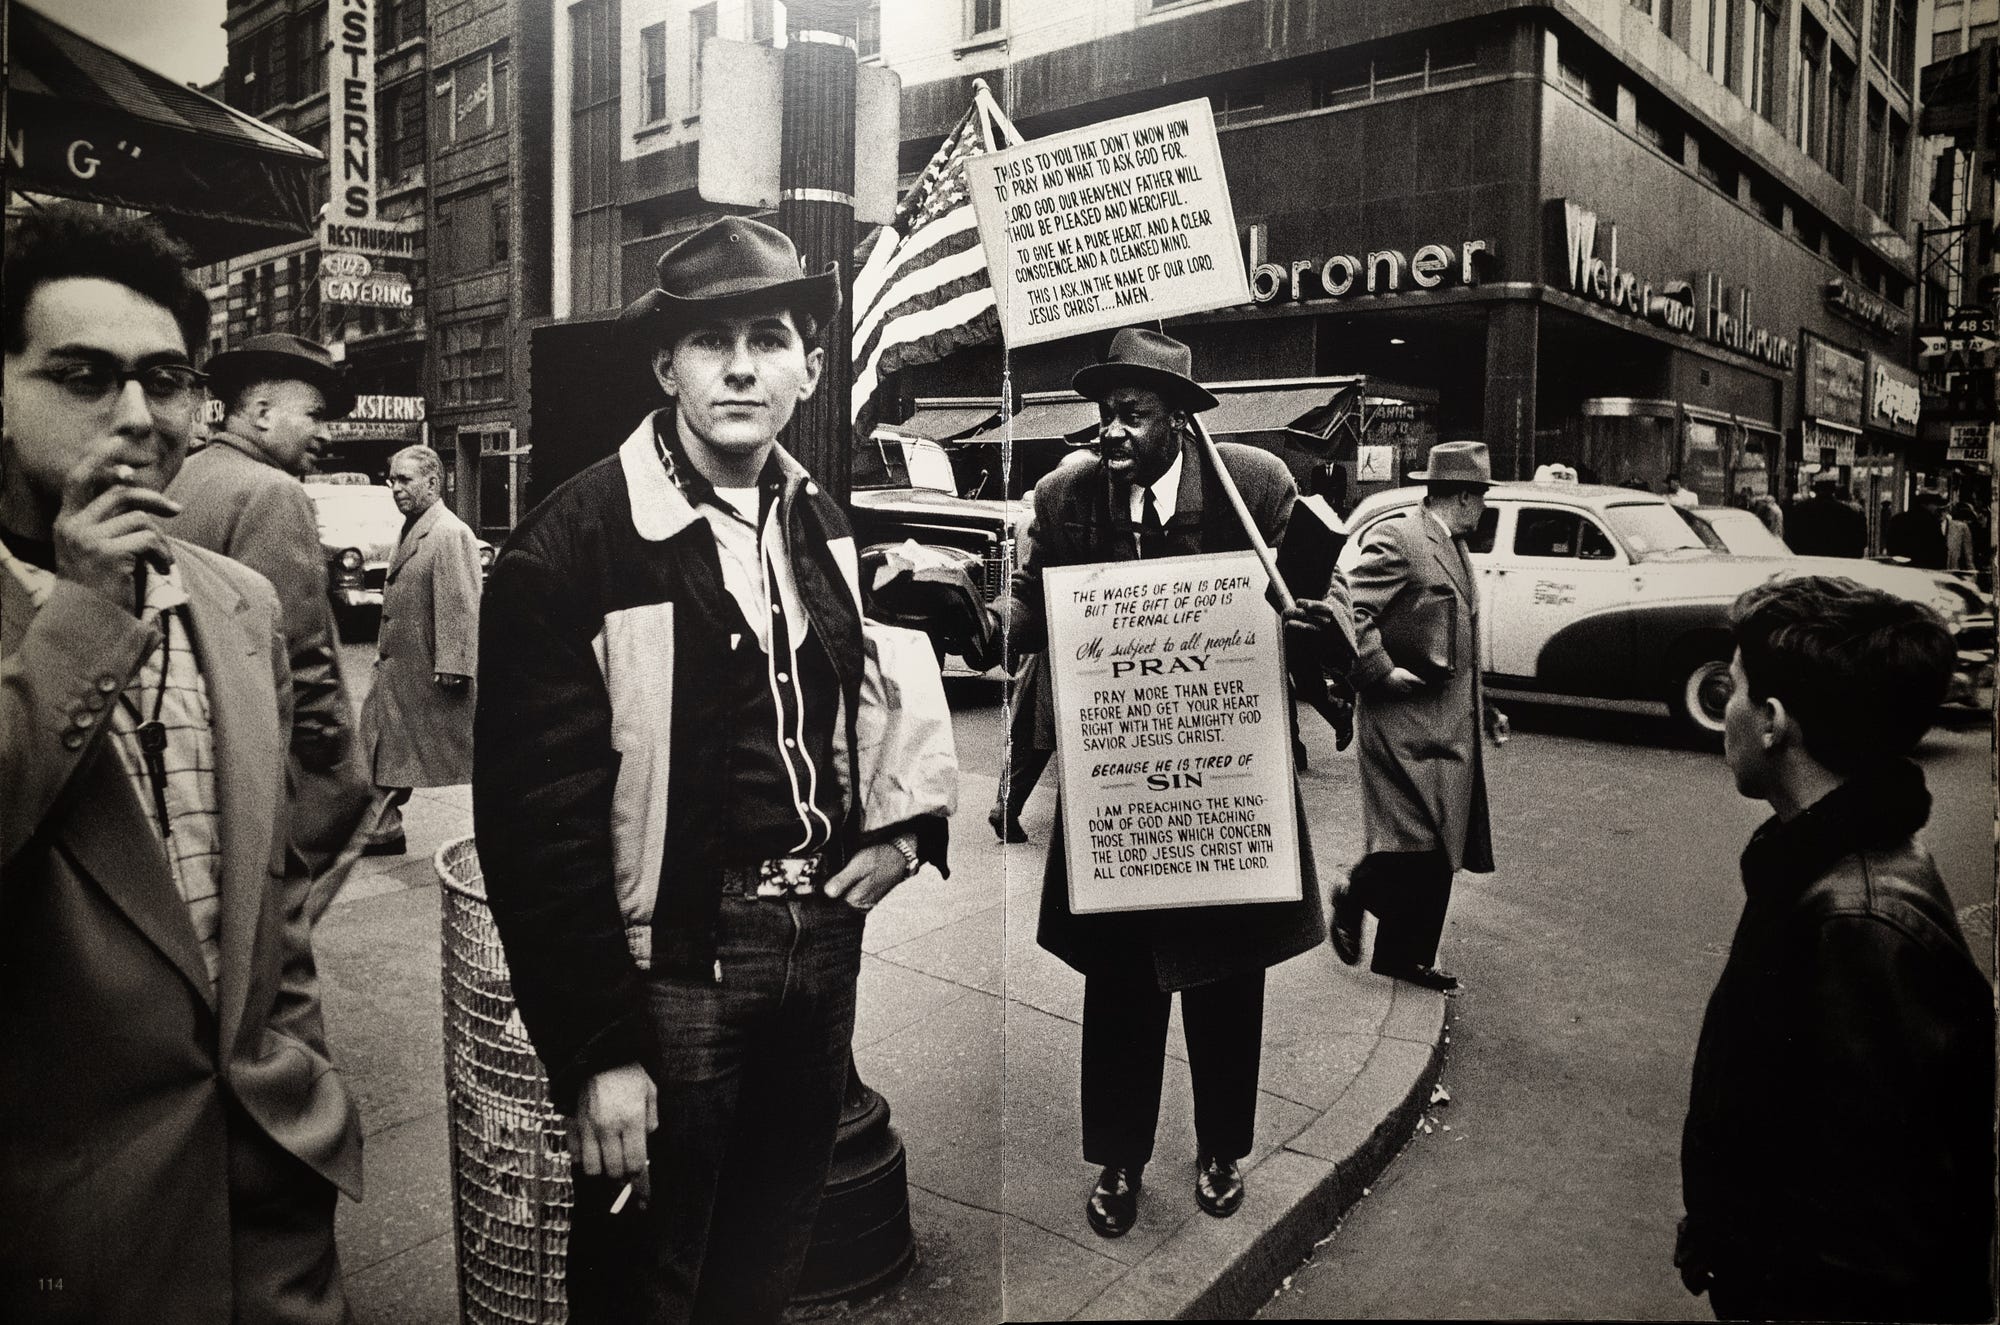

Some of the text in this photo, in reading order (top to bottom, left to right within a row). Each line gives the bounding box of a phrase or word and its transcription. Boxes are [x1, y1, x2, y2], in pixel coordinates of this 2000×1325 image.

[343, 0, 369, 218] STERNS
[993, 119, 1189, 184] THIS IS TO YOU THAT DON'T KNOW HOW
[994, 141, 1187, 203] TO PRAY AND WHAT TO ASK GOD FOR.
[1058, 191, 1079, 211] OUR
[1079, 178, 1132, 206] HEAVENLY
[1136, 169, 1175, 193] FATHER
[1174, 165, 1203, 184] WILL
[1038, 217, 1053, 236] BE
[1054, 206, 1102, 232] PLEASED
[1104, 201, 1128, 221] AND
[1128, 189, 1188, 215] MERCIFUL.
[328, 223, 413, 253] RESTAURANT
[1017, 248, 1030, 265] TO
[1033, 242, 1056, 262] GIVE
[1057, 238, 1074, 257] ME
[1075, 237, 1084, 252] A
[1084, 230, 1112, 250] PURE
[1147, 217, 1169, 237] AND
[1171, 216, 1180, 232] A
[1180, 209, 1212, 230] CLEAR
[1076, 252, 1098, 271] AND
[1100, 250, 1109, 266] A
[1110, 239, 1160, 264] CLEANSED
[1160, 233, 1191, 254] MIND.
[1027, 287, 1051, 305] THIS
[1053, 286, 1059, 301] I
[1080, 278, 1094, 295] IN
[1093, 274, 1114, 292] THE
[1114, 267, 1145, 288] NAME
[1147, 264, 1161, 281] OF
[1163, 259, 1186, 279] OUR
[1187, 254, 1215, 274] LORD.
[1565, 201, 1652, 317] Weber
[1706, 271, 1798, 370] Heilbroner
[327, 280, 413, 306] CATERING
[1028, 304, 1061, 326] JESUS
[1958, 320, 1977, 332] 48
[350, 395, 425, 421] KSTERN'S
[1073, 590, 1096, 604] THE
[1103, 584, 1147, 601] WAGES
[1153, 583, 1167, 596] OF
[1173, 581, 1192, 595] SIN
[1198, 580, 1208, 592] IS
[1085, 592, 1233, 618] BUT THE GIFT OF GOD IS
[1112, 613, 1169, 629] ETERNAL
[1076, 636, 1104, 663] My
[1109, 637, 1156, 660] subject
[1163, 636, 1174, 652] to
[1205, 629, 1242, 655] people
[1244, 631, 1256, 646] is
[1112, 653, 1211, 678] PRAY
[1094, 680, 1245, 704] PRAY MORE THAN EVER
[1079, 694, 1260, 722] BEFORE AND GET YOUR HEART
[1081, 709, 1262, 737] RIGHT WITH THE ALMIGHTY GOD
[1083, 728, 1225, 751] SAVIOR JESUS CHRIST.
[1091, 761, 1150, 778] BECAUSE
[1155, 759, 1173, 773] HE
[1177, 758, 1190, 771] IS
[1195, 755, 1233, 769] TIRED
[1146, 772, 1203, 791] SIN
[1096, 807, 1101, 817] I
[1104, 804, 1122, 817] AM
[1128, 799, 1202, 815] PREACHING
[1206, 797, 1230, 810] THE
[1089, 809, 1255, 833] DOM OF GOD AND TEACHING
[1091, 823, 1272, 849] THOSE THINGS WHICH CONCERN
[1092, 840, 1274, 865] THE LORD JESUS CHRIST WITH
[1094, 856, 1269, 880] ALL CONFIDENCE IN THE LORD.
[39, 1278, 64, 1291] 114
